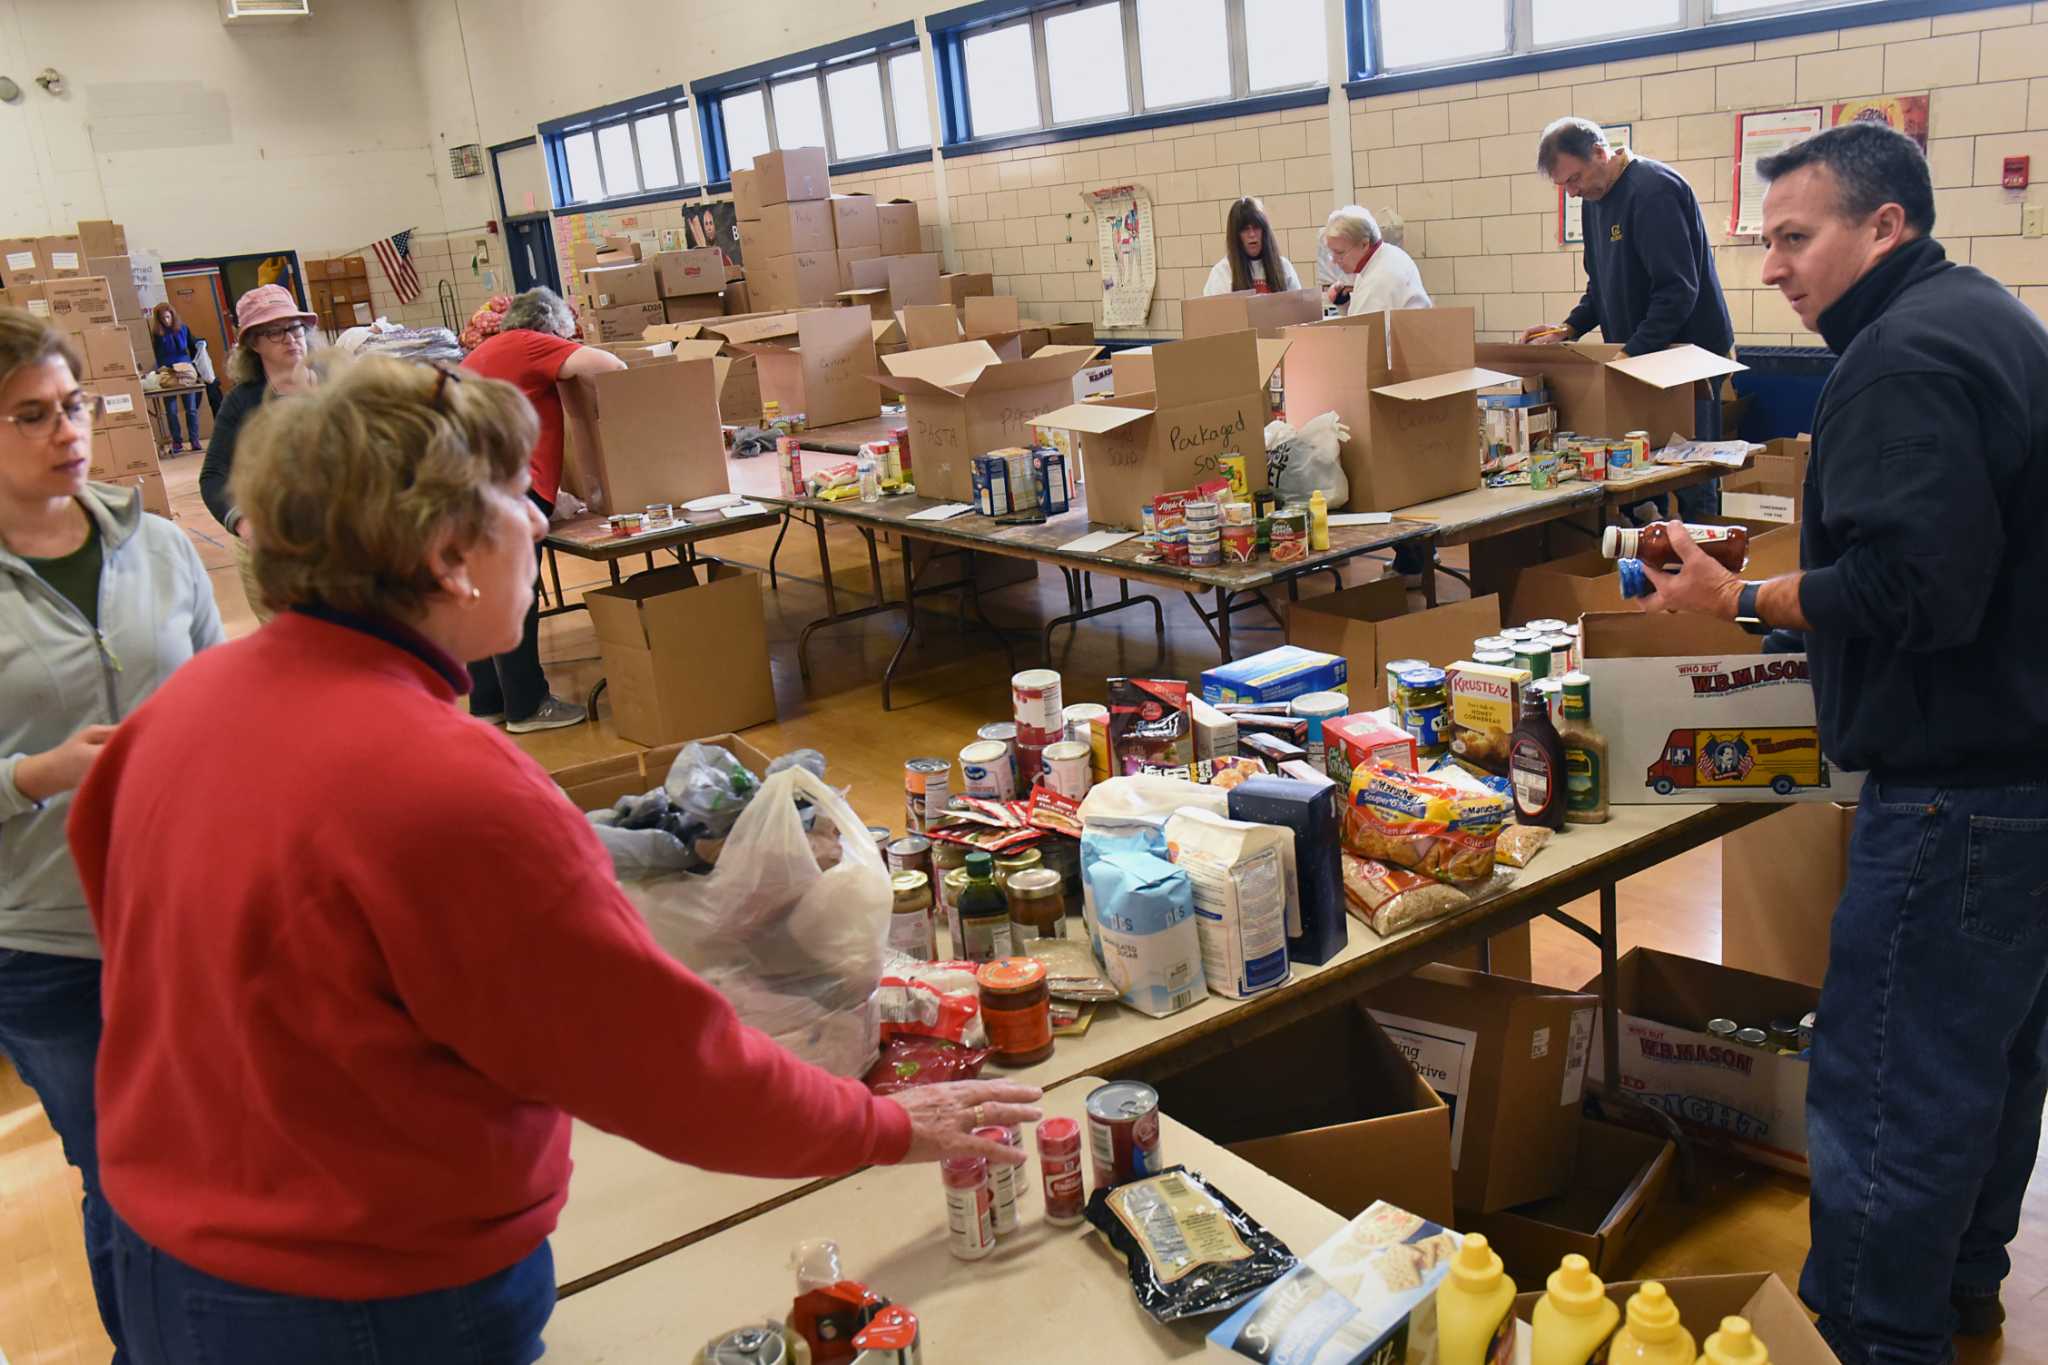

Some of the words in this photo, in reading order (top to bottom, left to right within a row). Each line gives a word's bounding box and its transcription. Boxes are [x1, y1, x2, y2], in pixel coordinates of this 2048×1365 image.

[917, 420, 960, 449] PASTA
[1169, 410, 1246, 453] Packaged
[1679, 665, 1699, 674] WHO
[1701, 664, 1719, 673] BUT
[1454, 677, 1509, 699] KRUSTEAZ
[1463, 713, 1502, 725] CORNBREAD
